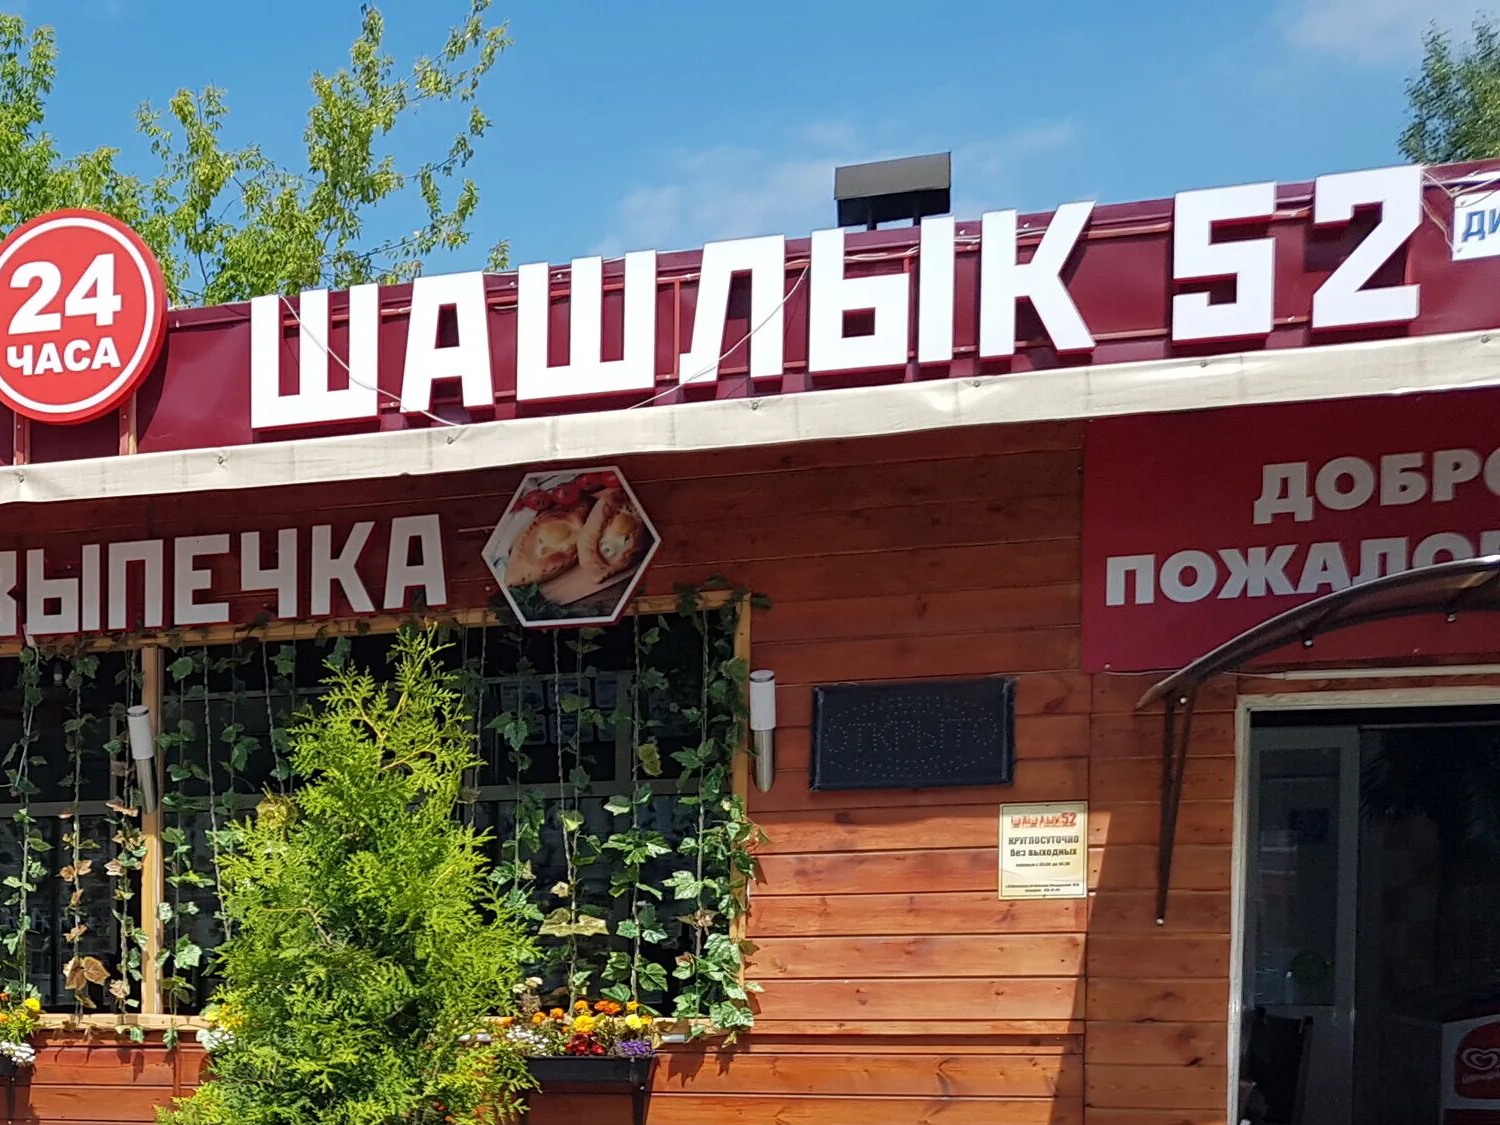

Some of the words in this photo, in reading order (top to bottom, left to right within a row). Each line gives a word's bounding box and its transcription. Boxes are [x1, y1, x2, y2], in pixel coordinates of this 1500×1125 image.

[8, 252, 123, 336] 24
[251, 201, 1096, 430] ШАШЛЫК
[1172, 164, 1423, 342] 52
[6, 336, 122, 377] ЧАСА
[1105, 528, 1500, 606] ПОЖАЛО
[824, 717, 998, 753] ОТКРЫТО
[1008, 835, 1079, 845] КРУГЛОСУТОЧНО
[1028, 848, 1077, 857] выходных
